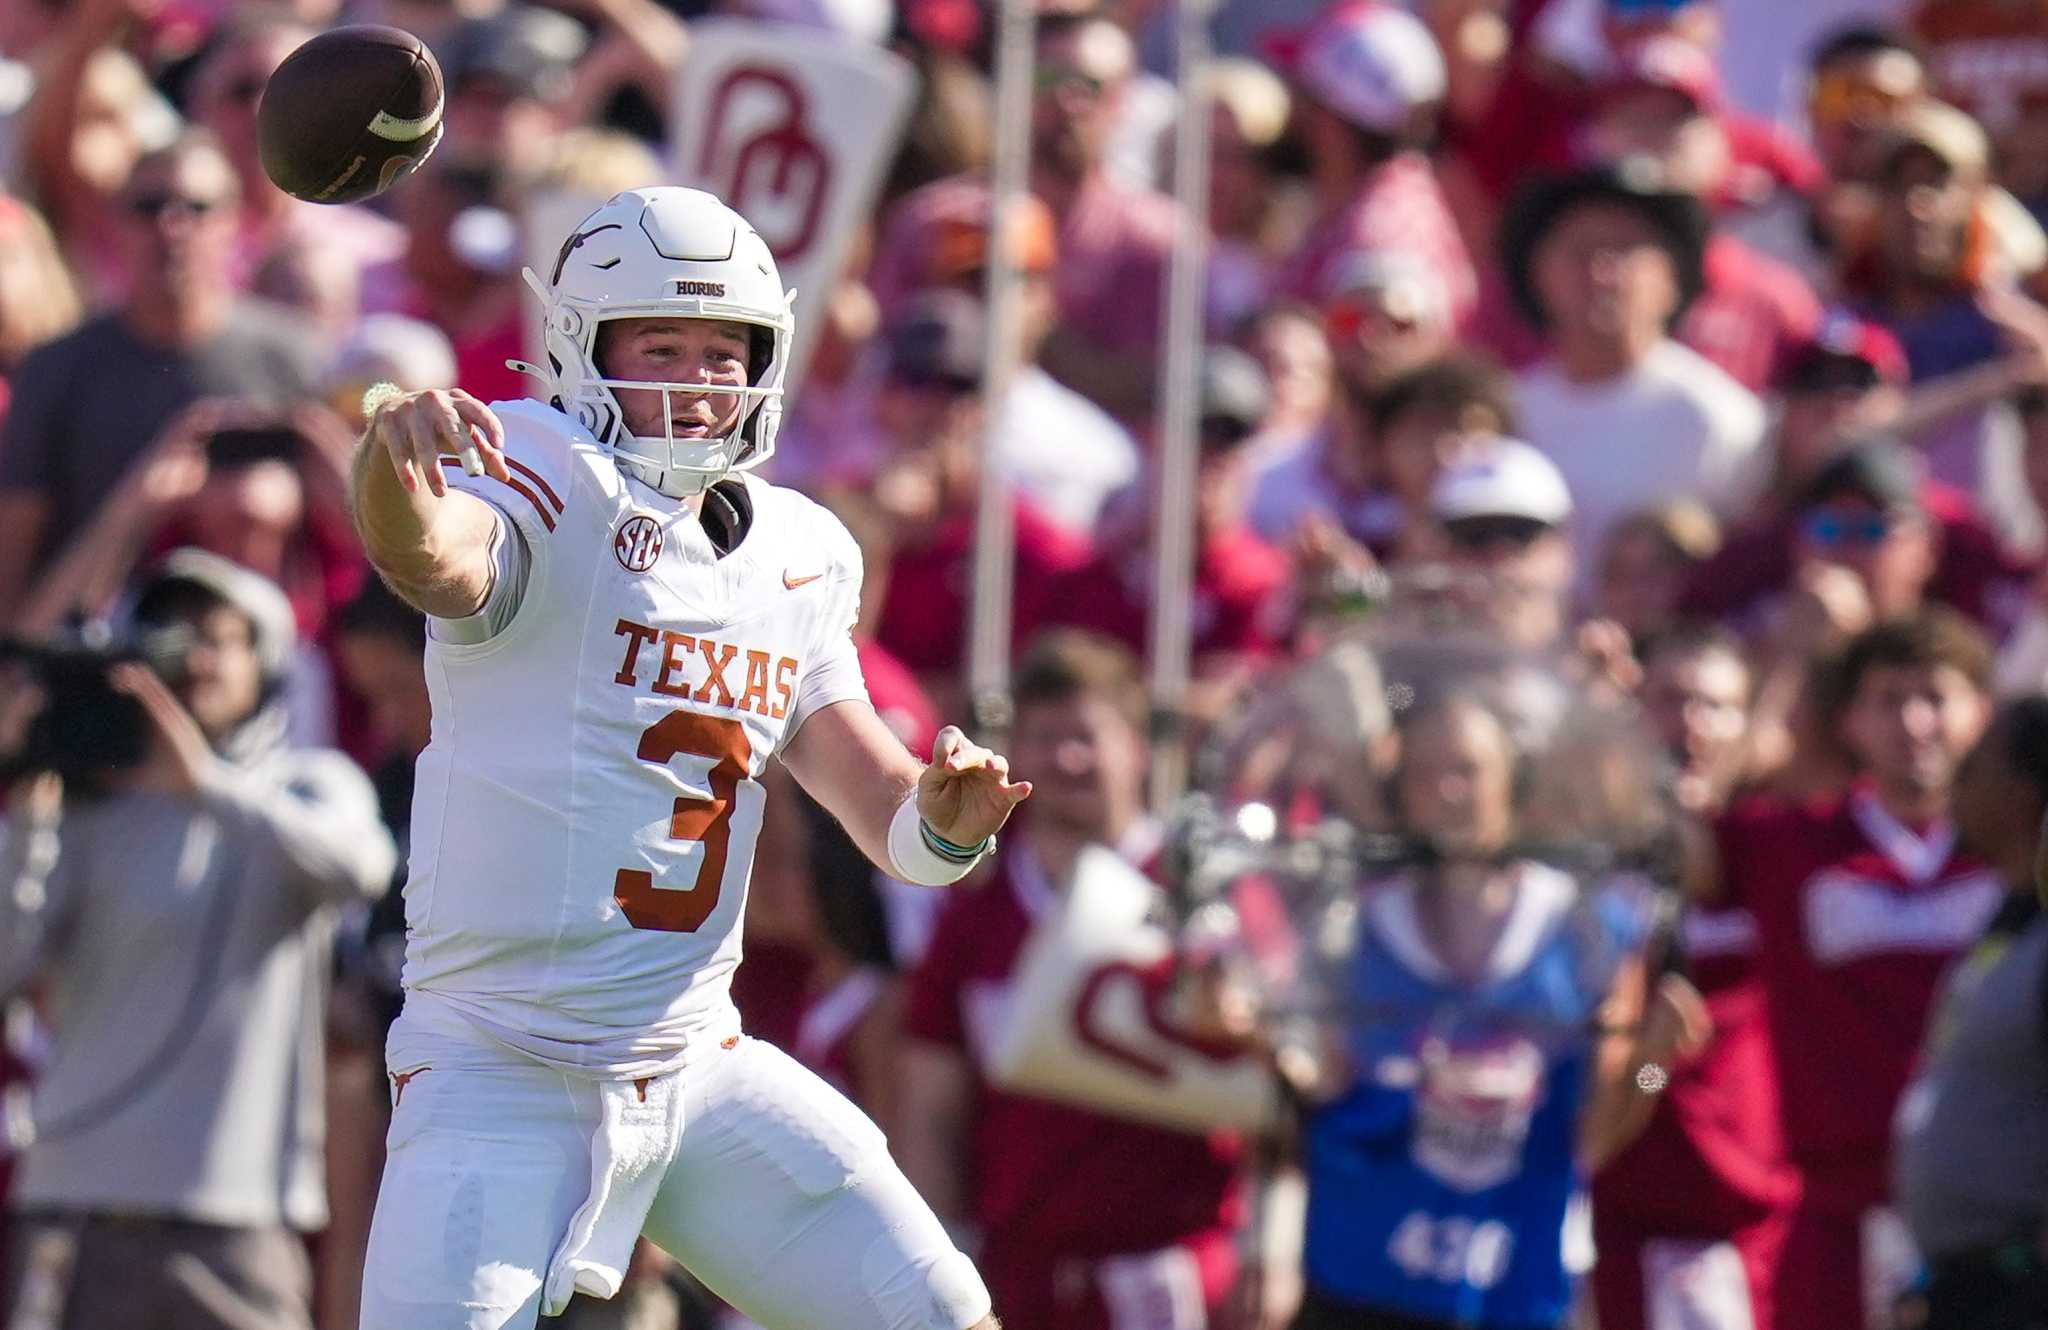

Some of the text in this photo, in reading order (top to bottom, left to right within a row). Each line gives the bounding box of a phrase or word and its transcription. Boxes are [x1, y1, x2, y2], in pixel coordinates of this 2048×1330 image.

[676, 281, 725, 298] HORNS
[617, 519, 661, 569] SEC
[614, 618, 798, 720] TEXAS
[613, 709, 752, 933] 3
